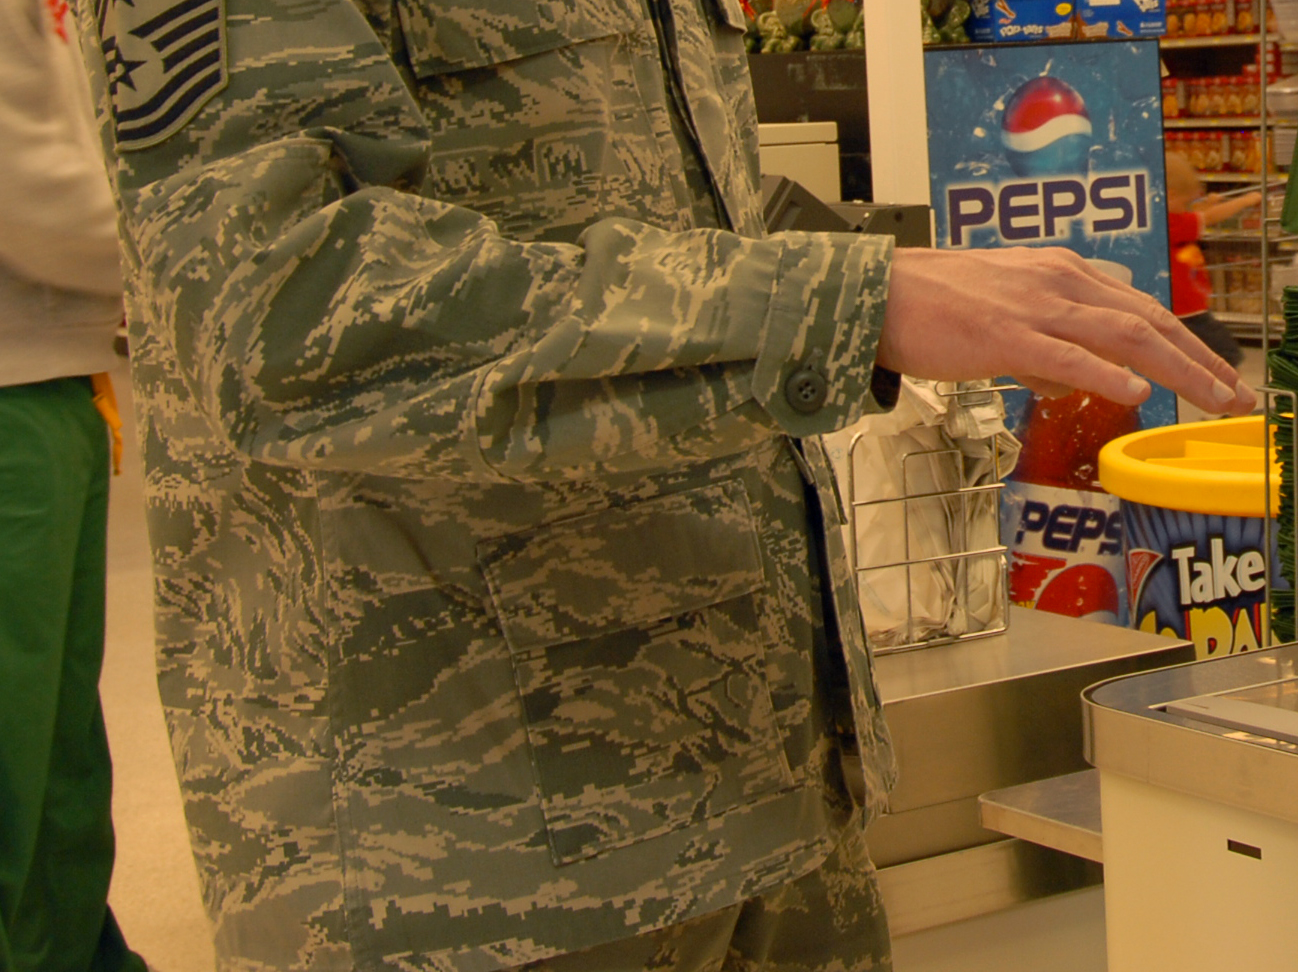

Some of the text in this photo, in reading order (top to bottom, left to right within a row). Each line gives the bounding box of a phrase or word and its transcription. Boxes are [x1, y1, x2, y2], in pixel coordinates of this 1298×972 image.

[947, 173, 1148, 247] PEPSI
[1014, 499, 1123, 556] PEPS
[1171, 537, 1267, 606] Take
